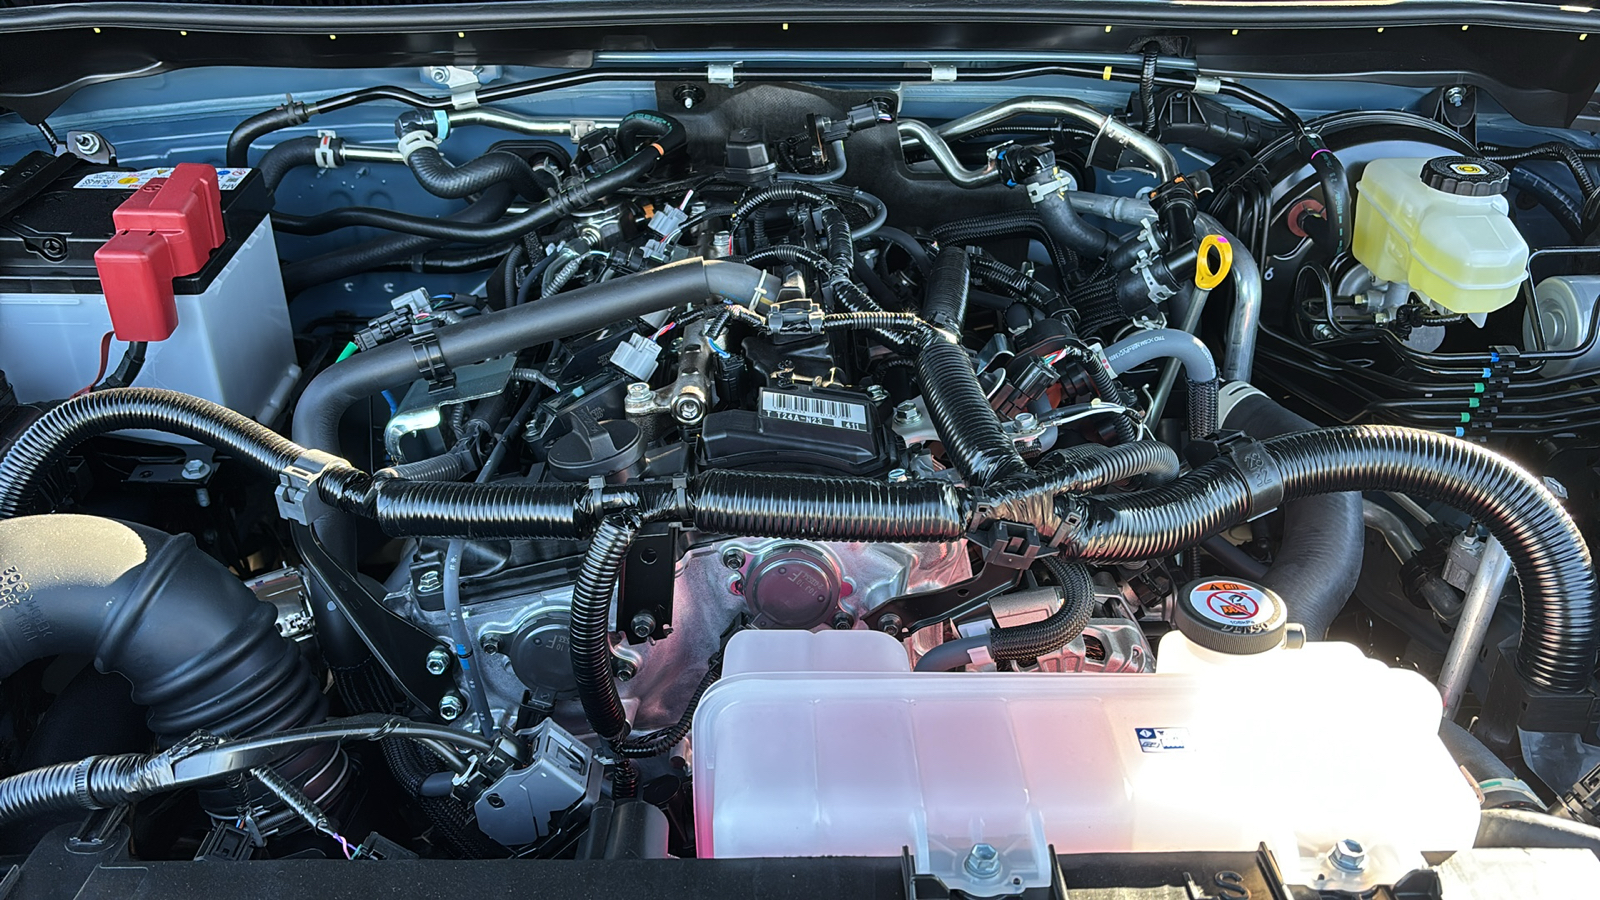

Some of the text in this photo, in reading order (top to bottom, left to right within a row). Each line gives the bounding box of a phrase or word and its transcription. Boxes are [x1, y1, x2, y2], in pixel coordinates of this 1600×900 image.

[765, 410, 772, 418] T
[776, 411, 823, 425] T24A-N23
[787, 570, 803, 583] F
[1220, 621, 1269, 635] DENSO
[545, 634, 558, 649] F
[1214, 870, 1251, 900] S
